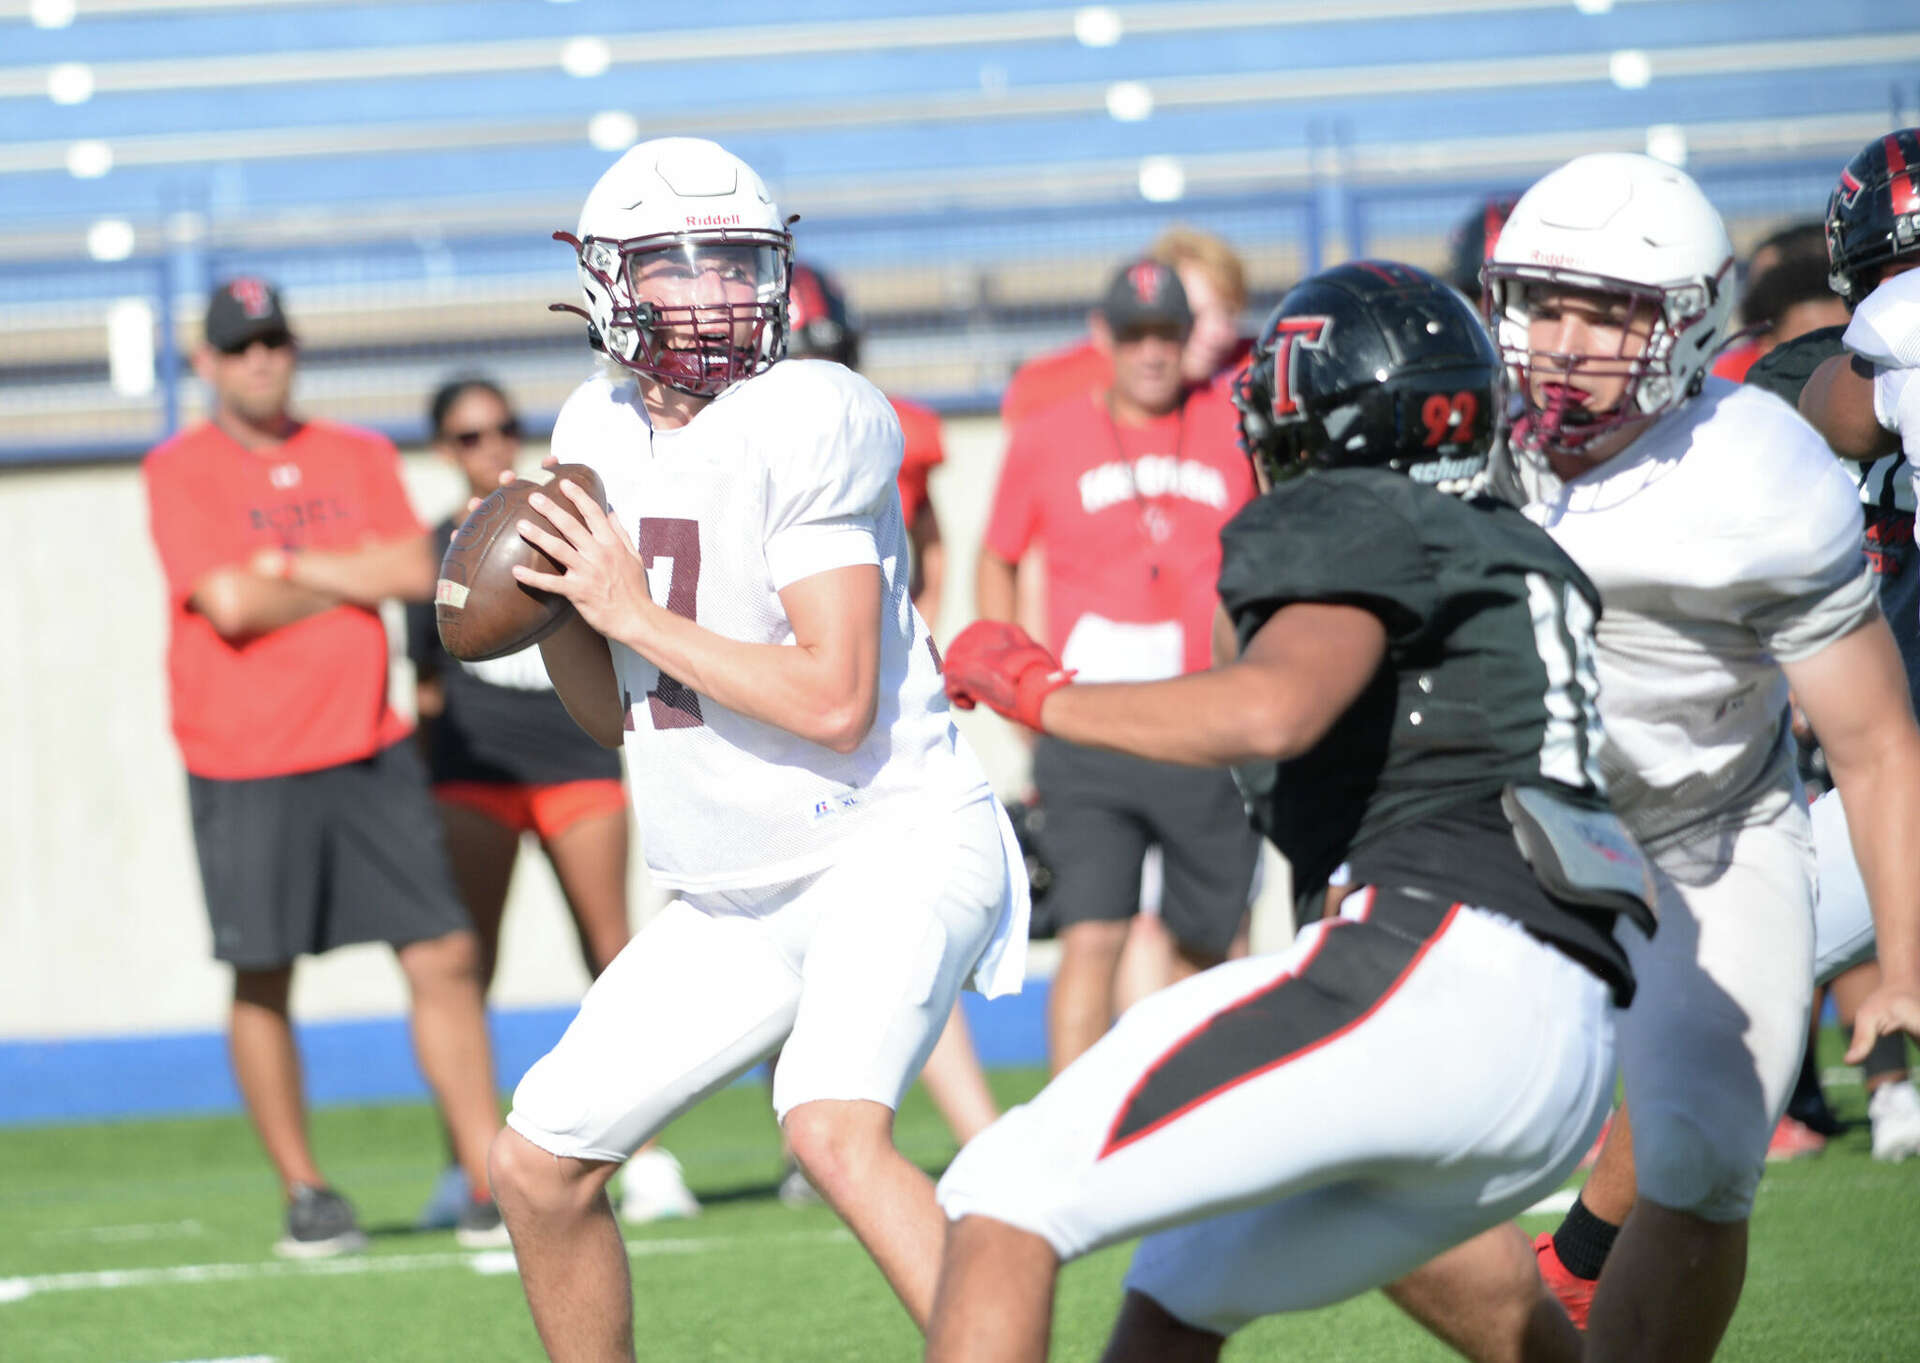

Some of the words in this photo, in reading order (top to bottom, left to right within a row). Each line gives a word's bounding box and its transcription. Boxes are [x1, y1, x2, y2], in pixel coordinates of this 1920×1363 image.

[685, 213, 742, 227] Riddell
[1421, 389, 1478, 447] 92
[623, 516, 704, 732] 7
